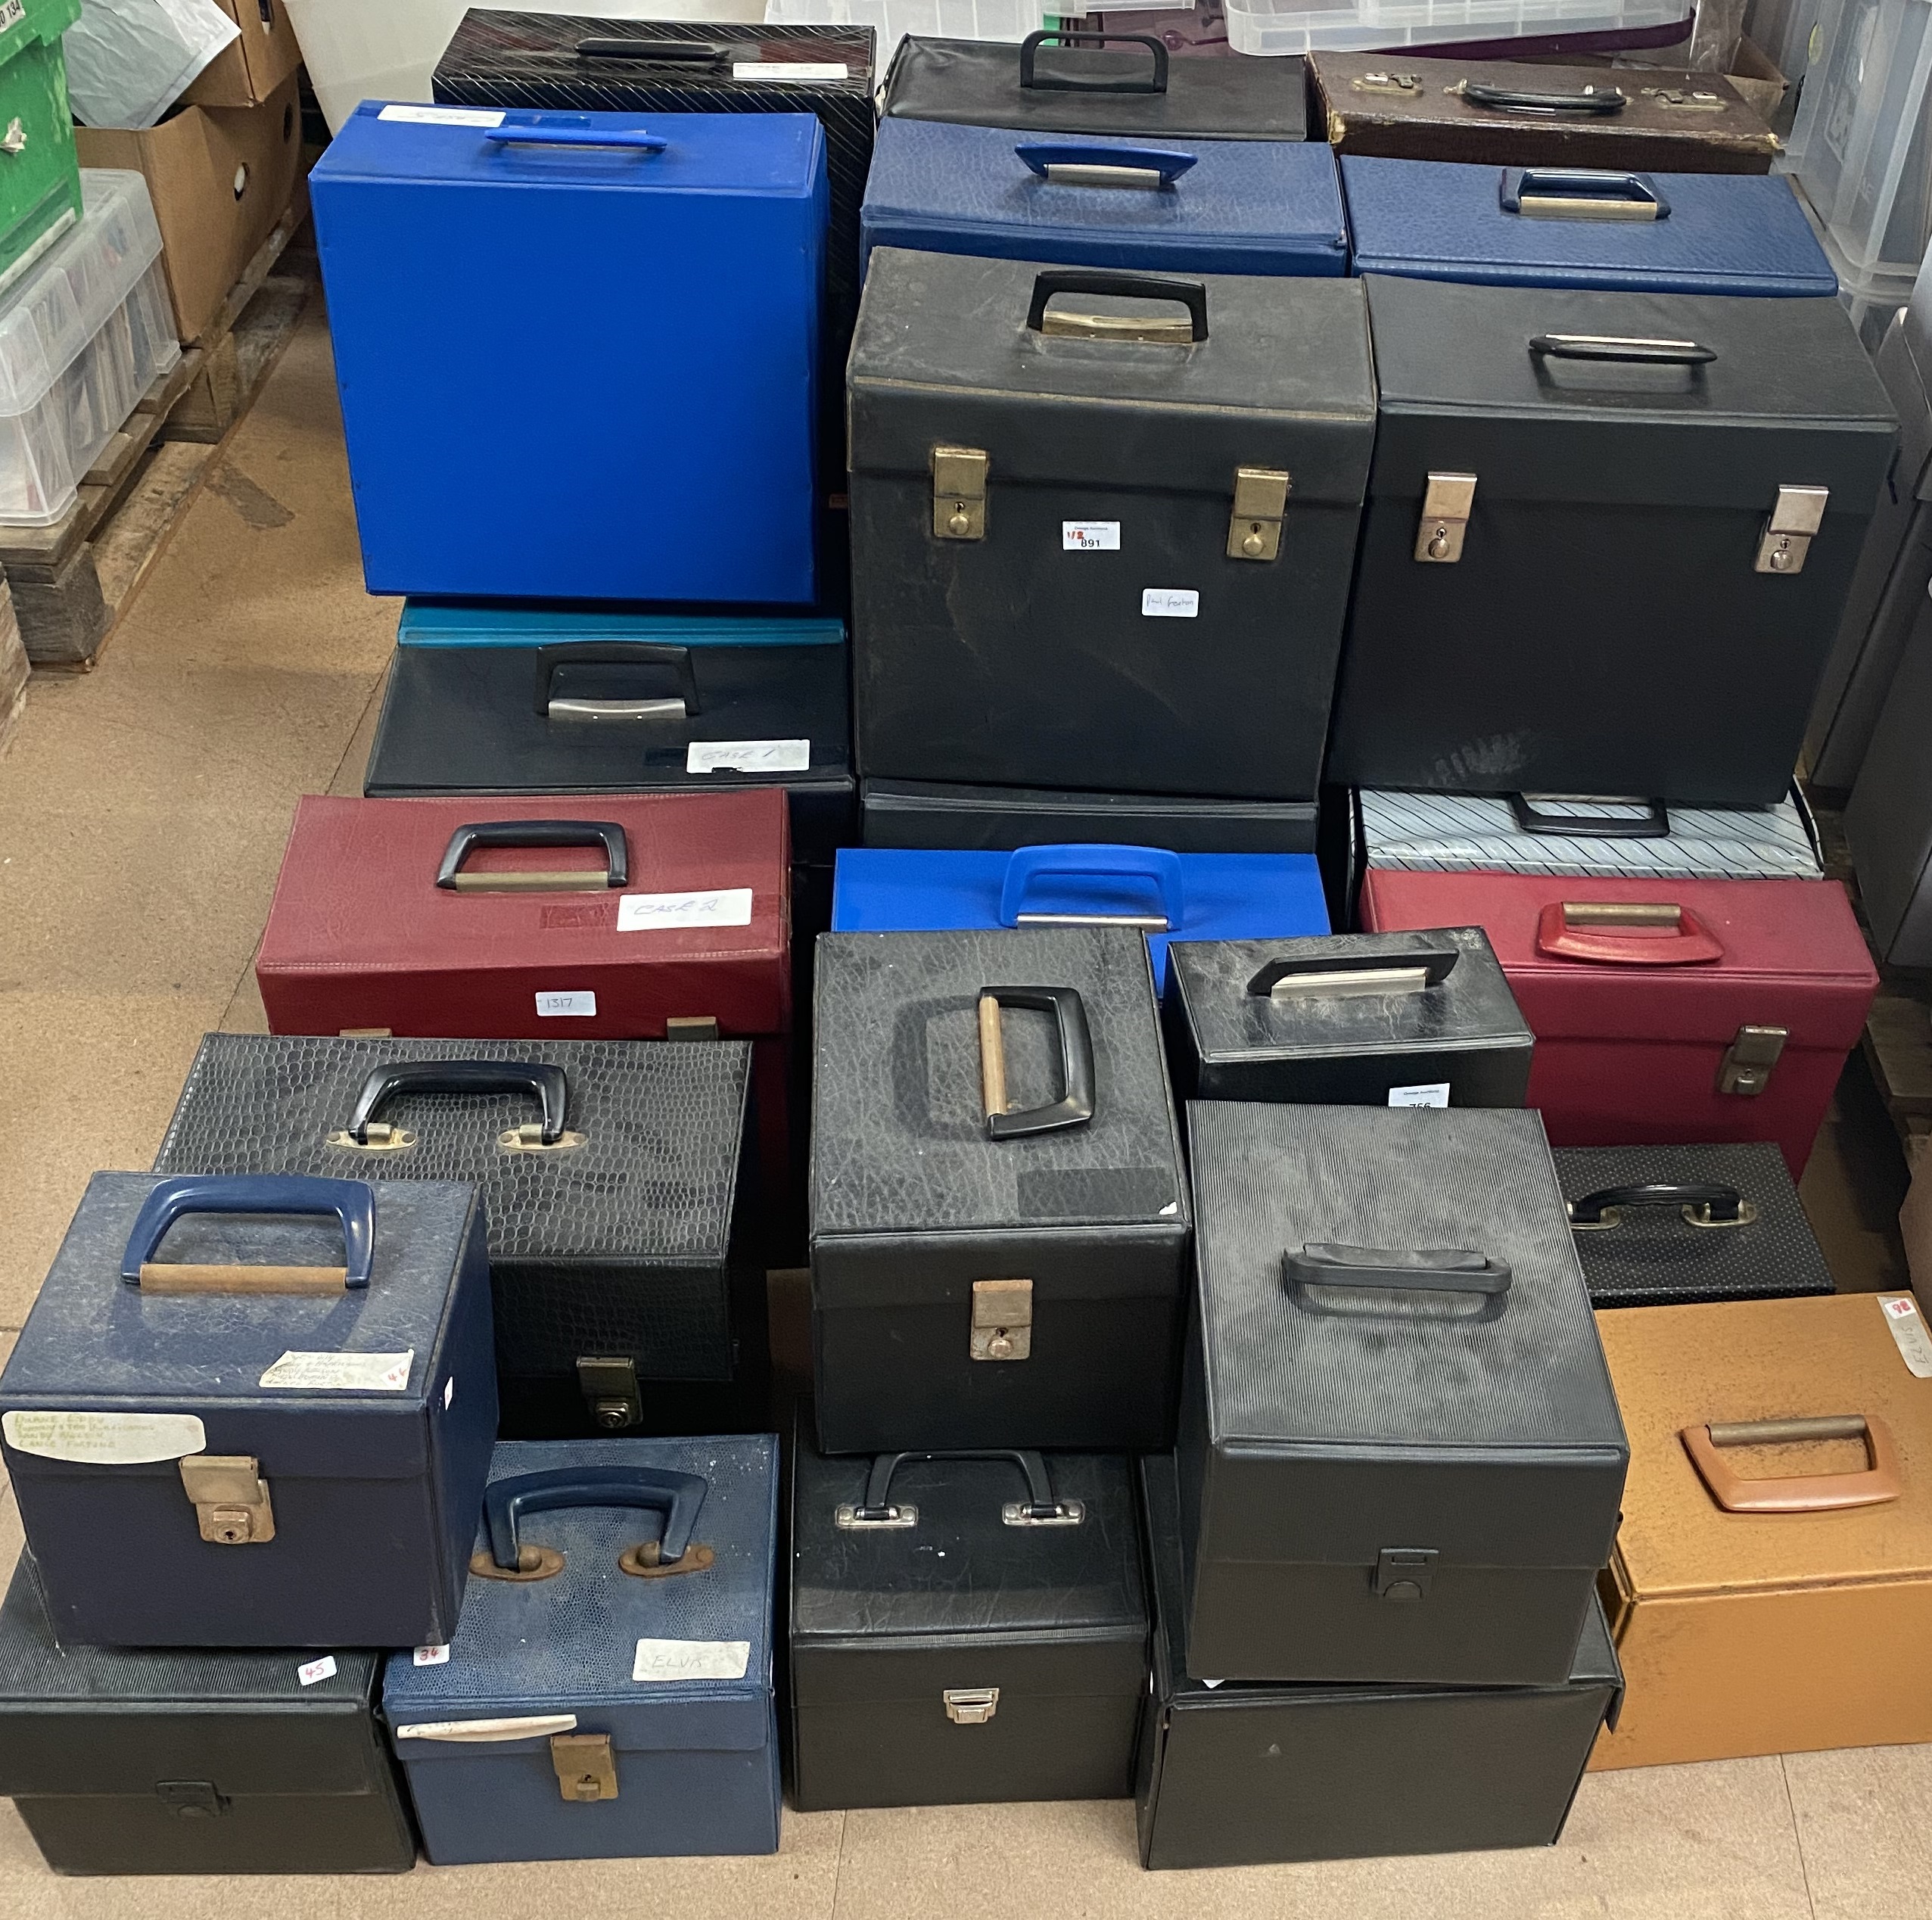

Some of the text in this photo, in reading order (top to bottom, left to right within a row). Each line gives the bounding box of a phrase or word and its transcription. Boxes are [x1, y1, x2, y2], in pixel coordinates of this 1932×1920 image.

[1081, 539, 1100, 548] 891
[634, 900, 696, 915] CASE
[547, 997, 573, 1009] 1317
[1901, 1326, 1930, 1365] ELVIS
